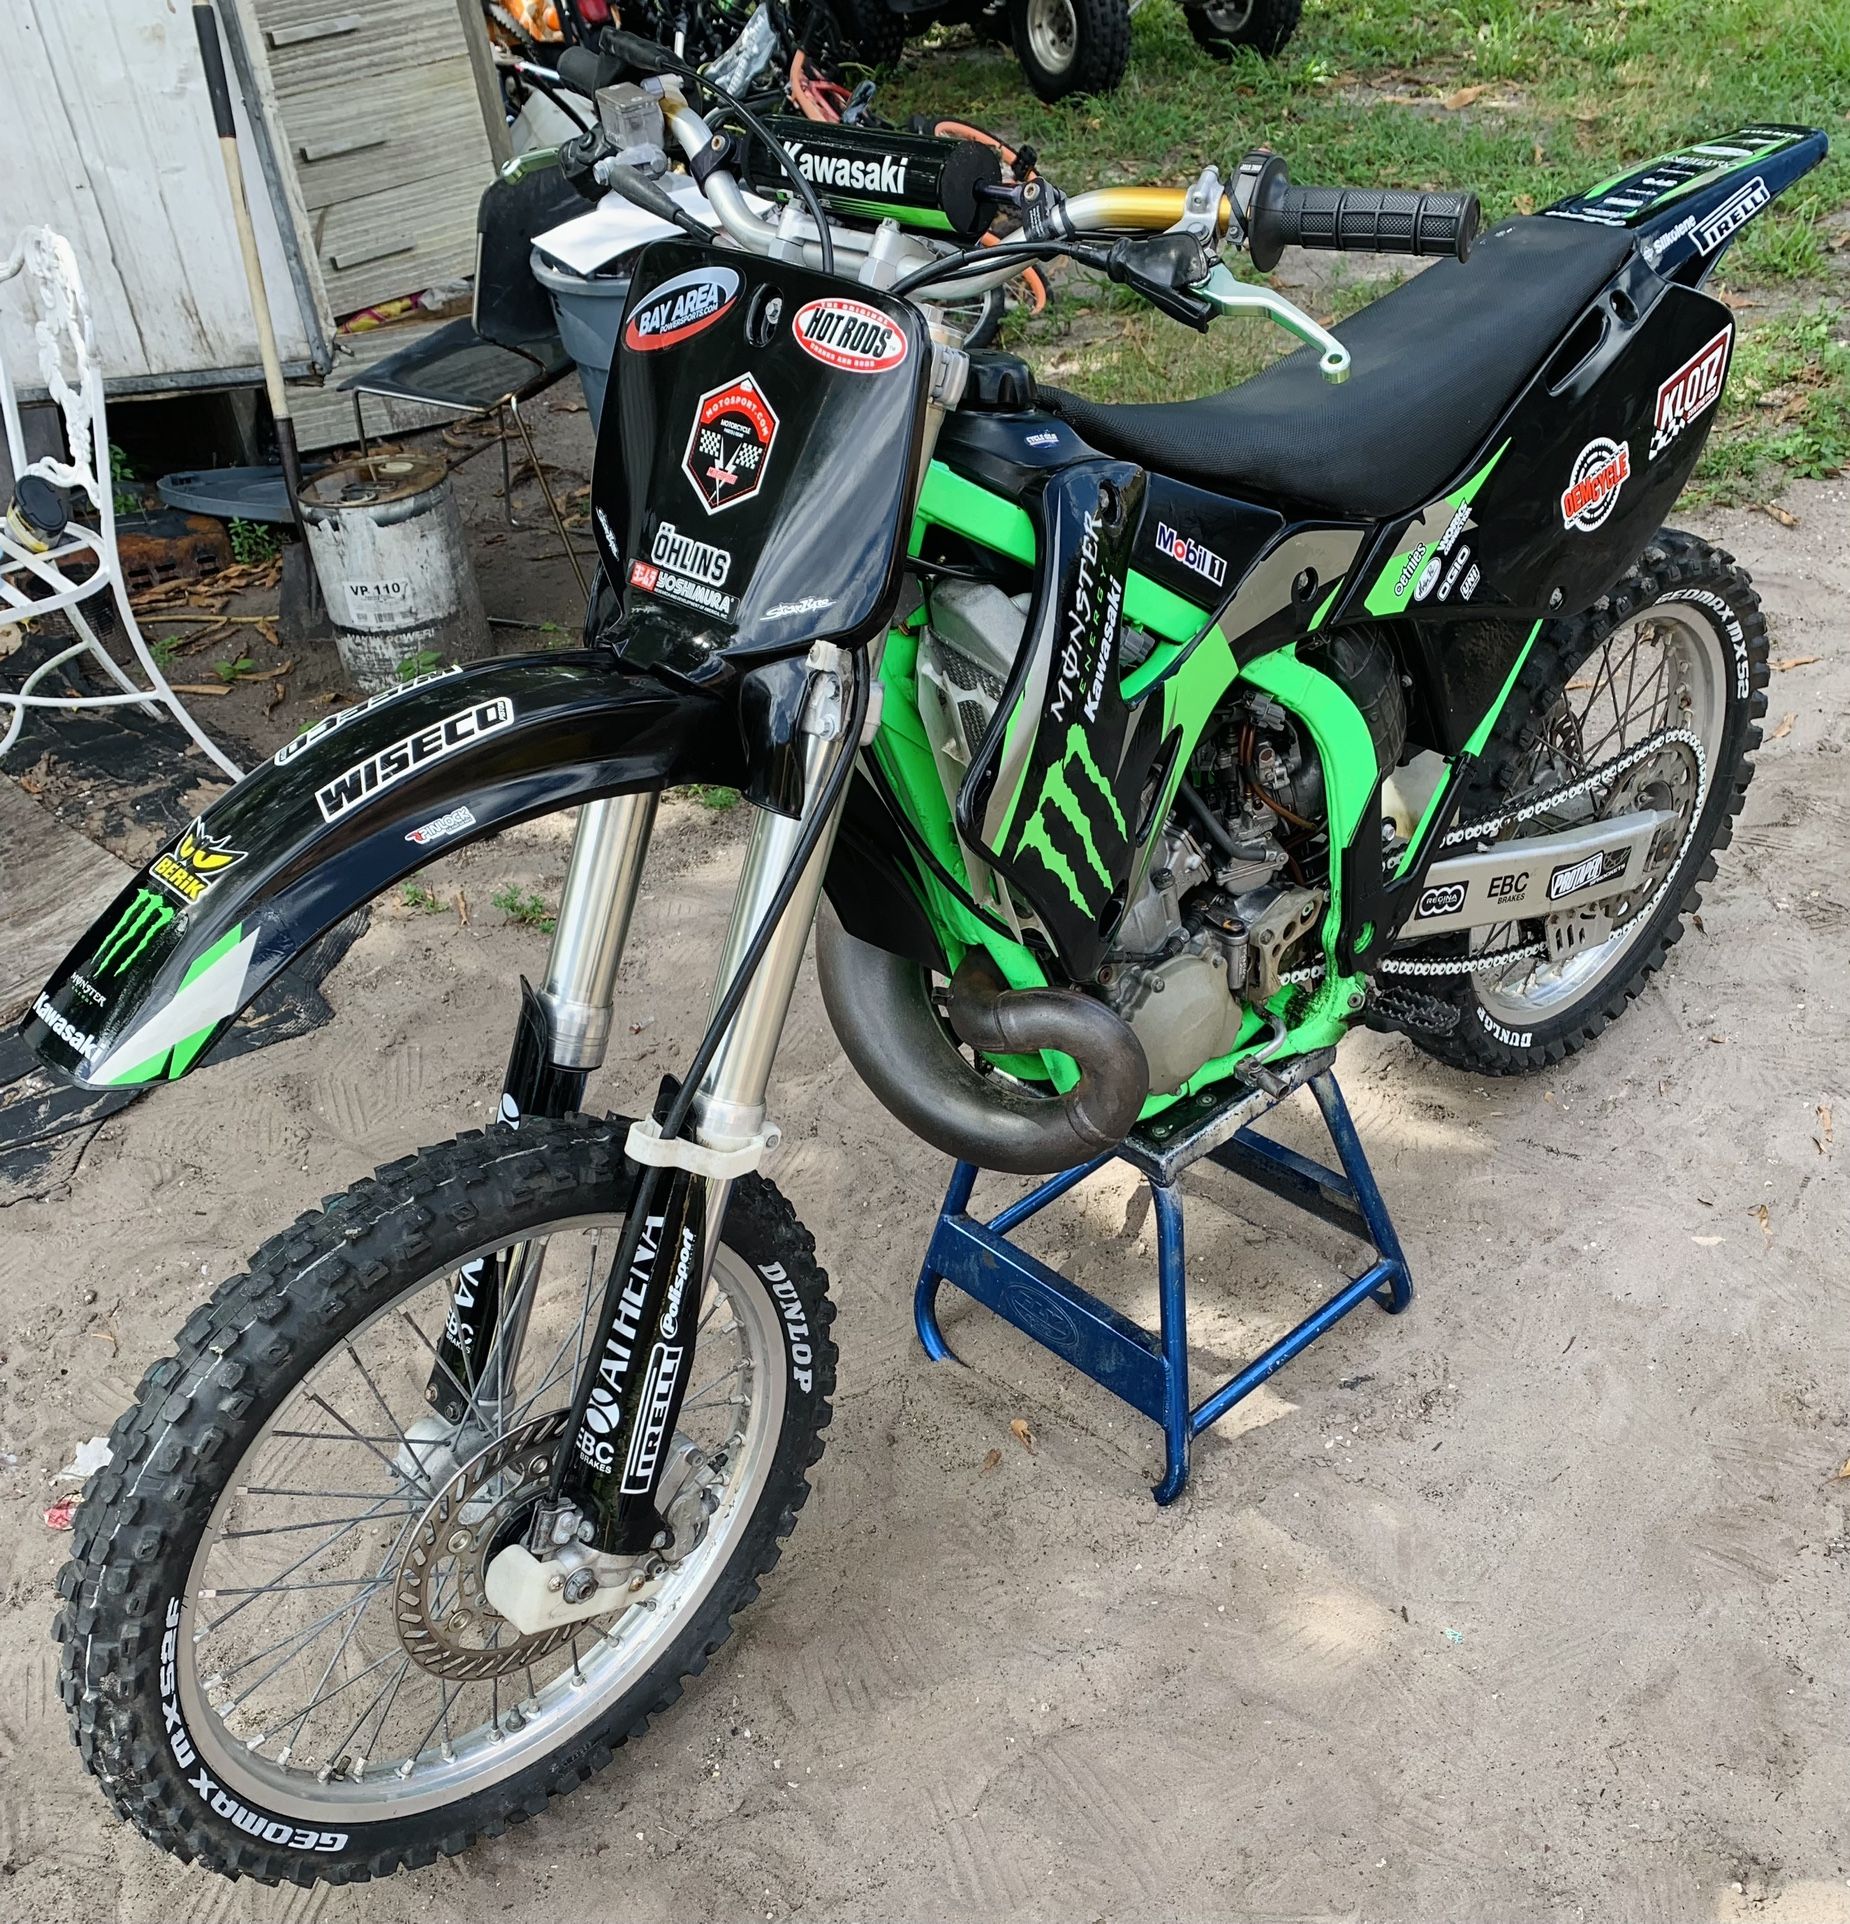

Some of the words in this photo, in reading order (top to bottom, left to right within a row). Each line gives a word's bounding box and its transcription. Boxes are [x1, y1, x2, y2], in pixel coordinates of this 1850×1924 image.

[780, 141, 908, 194] Kawasaki
[1653, 214, 1697, 254] Silkolene
[1690, 177, 1769, 256] PIRELLI
[639, 300, 672, 337] BAY
[671, 282, 719, 320] AREA
[660, 302, 719, 333] POWERSPORTS.COM
[820, 301, 839, 310] THE
[804, 307, 844, 345] HOT
[836, 316, 893, 358] RODS
[1660, 343, 1724, 432] KLOTZ
[705, 395, 770, 438] MOTOSPORT.COM
[720, 419, 752, 435] MOTORCYCLE
[1563, 451, 1628, 518] OEMCYCLE
[1156, 524, 1207, 573] Mobil
[1437, 497, 1468, 551] WORKS
[653, 525, 730, 582] ÖHLINS
[1439, 546, 1470, 600] OGIO
[1462, 565, 1479, 593] UNI
[350, 585, 368, 596] VP
[374, 582, 400, 595] 110
[656, 571, 731, 613] YOSHIMURA
[1079, 563, 1107, 695] ENERGY
[1084, 574, 1122, 724] Kawasaki
[1653, 588, 1735, 622] GEOMAX
[1726, 619, 1750, 700] MX52
[319, 701, 500, 818] WISECO
[417, 806, 471, 839] PINLOCK
[1426, 892, 1458, 905] REGINA
[1487, 871, 1530, 898] EBC
[1497, 892, 1526, 905] BRAKES
[32, 990, 107, 1064] Kawasaki
[1476, 1006, 1533, 1048] DUNLOP
[662, 1225, 695, 1338] Polisport
[446, 1331, 471, 1354] BRAKS
[758, 1261, 813, 1394] DUNLOP
[620, 1343, 683, 1494] PIRELLI
[579, 1451, 613, 1475] BRAKES
[160, 1596, 192, 1769] MX52F
[188, 1767, 349, 1852] GEOMAX
